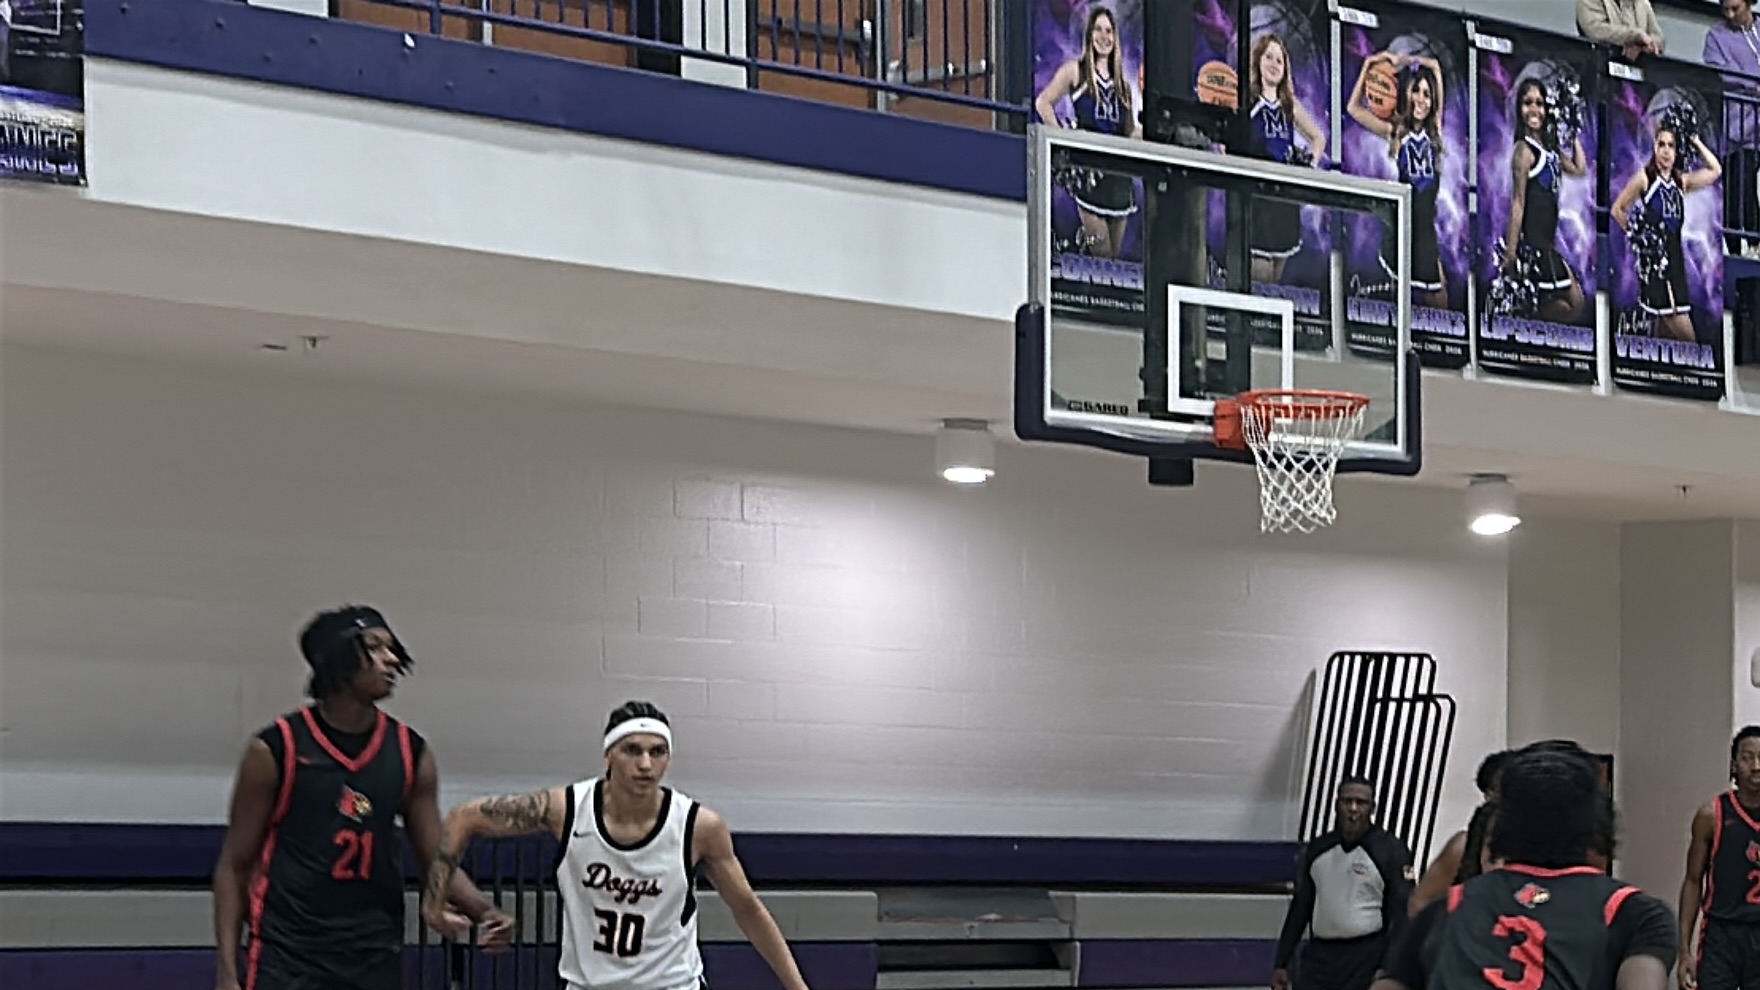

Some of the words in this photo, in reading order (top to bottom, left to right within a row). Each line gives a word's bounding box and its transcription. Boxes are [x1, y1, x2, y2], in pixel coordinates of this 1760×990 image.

[1407, 142, 1434, 178] M
[1614, 333, 1715, 369] VENTURA
[331, 830, 374, 881] 21
[582, 862, 664, 904] Doggs
[593, 908, 645, 957] 30
